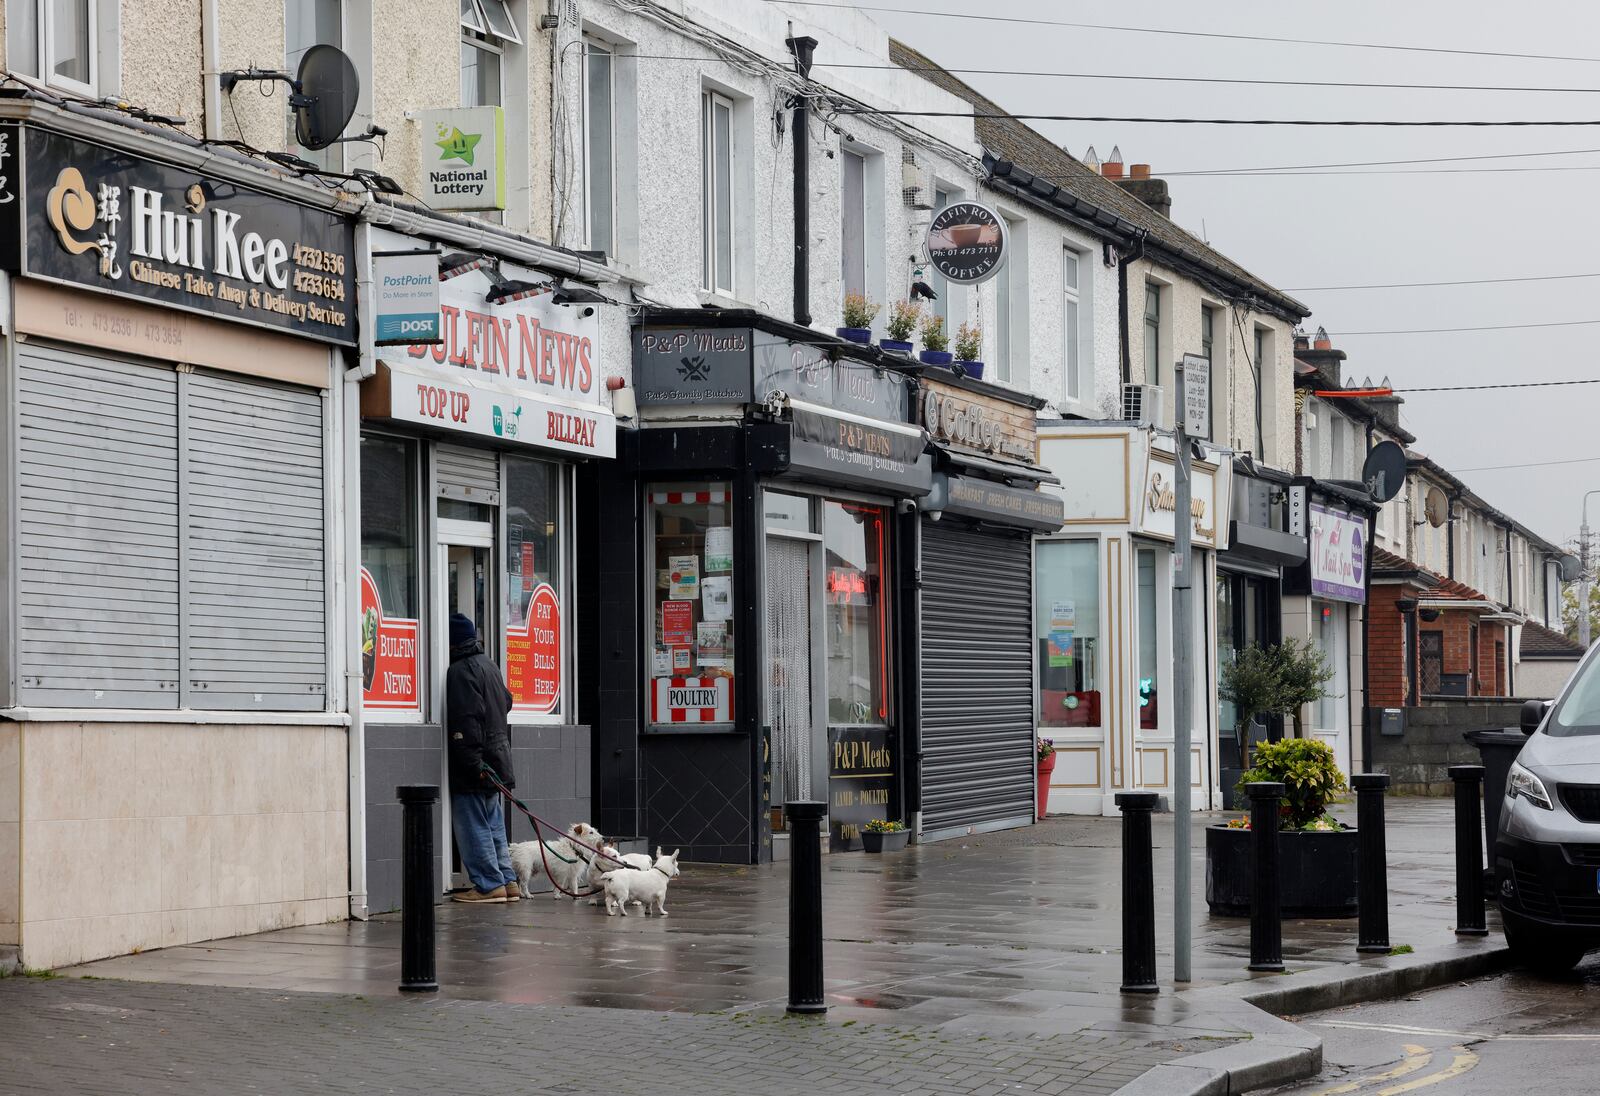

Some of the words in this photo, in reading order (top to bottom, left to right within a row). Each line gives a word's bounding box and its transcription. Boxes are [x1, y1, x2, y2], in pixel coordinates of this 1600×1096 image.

[429, 169, 488, 183] National
[433, 182, 484, 197] Lottery
[930, 205, 968, 239] BULFIN
[970, 206, 999, 234] ROAD
[129, 183, 206, 272] Hui
[211, 207, 289, 290] Kee
[292, 242, 346, 276] 4732536
[947, 249, 957, 257] 01
[959, 247, 976, 255] 473
[978, 246, 999, 254] 7111
[940, 257, 994, 279] COFFEE
[292, 268, 346, 303] 4733654
[383, 274, 433, 286] PostPoint
[129, 260, 182, 290] Chinese
[184, 272, 215, 298] Take
[217, 281, 248, 311] Away
[250, 292, 261, 308] &
[264, 291, 308, 323] Delivery
[307, 301, 347, 328] Service
[393, 291, 409, 299] More
[417, 290, 433, 298] Store
[407, 304, 510, 378] ULFIN
[516, 313, 593, 395] NEWS
[641, 332, 690, 355] P&P
[693, 332, 747, 353] Meats
[417, 383, 448, 420] TOP
[448, 391, 471, 424] UP
[546, 410, 598, 448] BILLPAY
[941, 398, 1001, 451] Coffee
[536, 602, 552, 620] PAY
[379, 634, 415, 659] BULFIN
[533, 627, 555, 645] YOUR
[533, 653, 555, 670] BILLS
[383, 671, 412, 695] NEWS
[534, 678, 555, 695] HERE
[669, 688, 717, 706] POULTRY
[834, 740, 859, 770] P&P
[860, 740, 891, 769] Meats
[835, 790, 853, 807] LAMB
[860, 789, 889, 805] POULTRY
[841, 824, 860, 840] PORK
